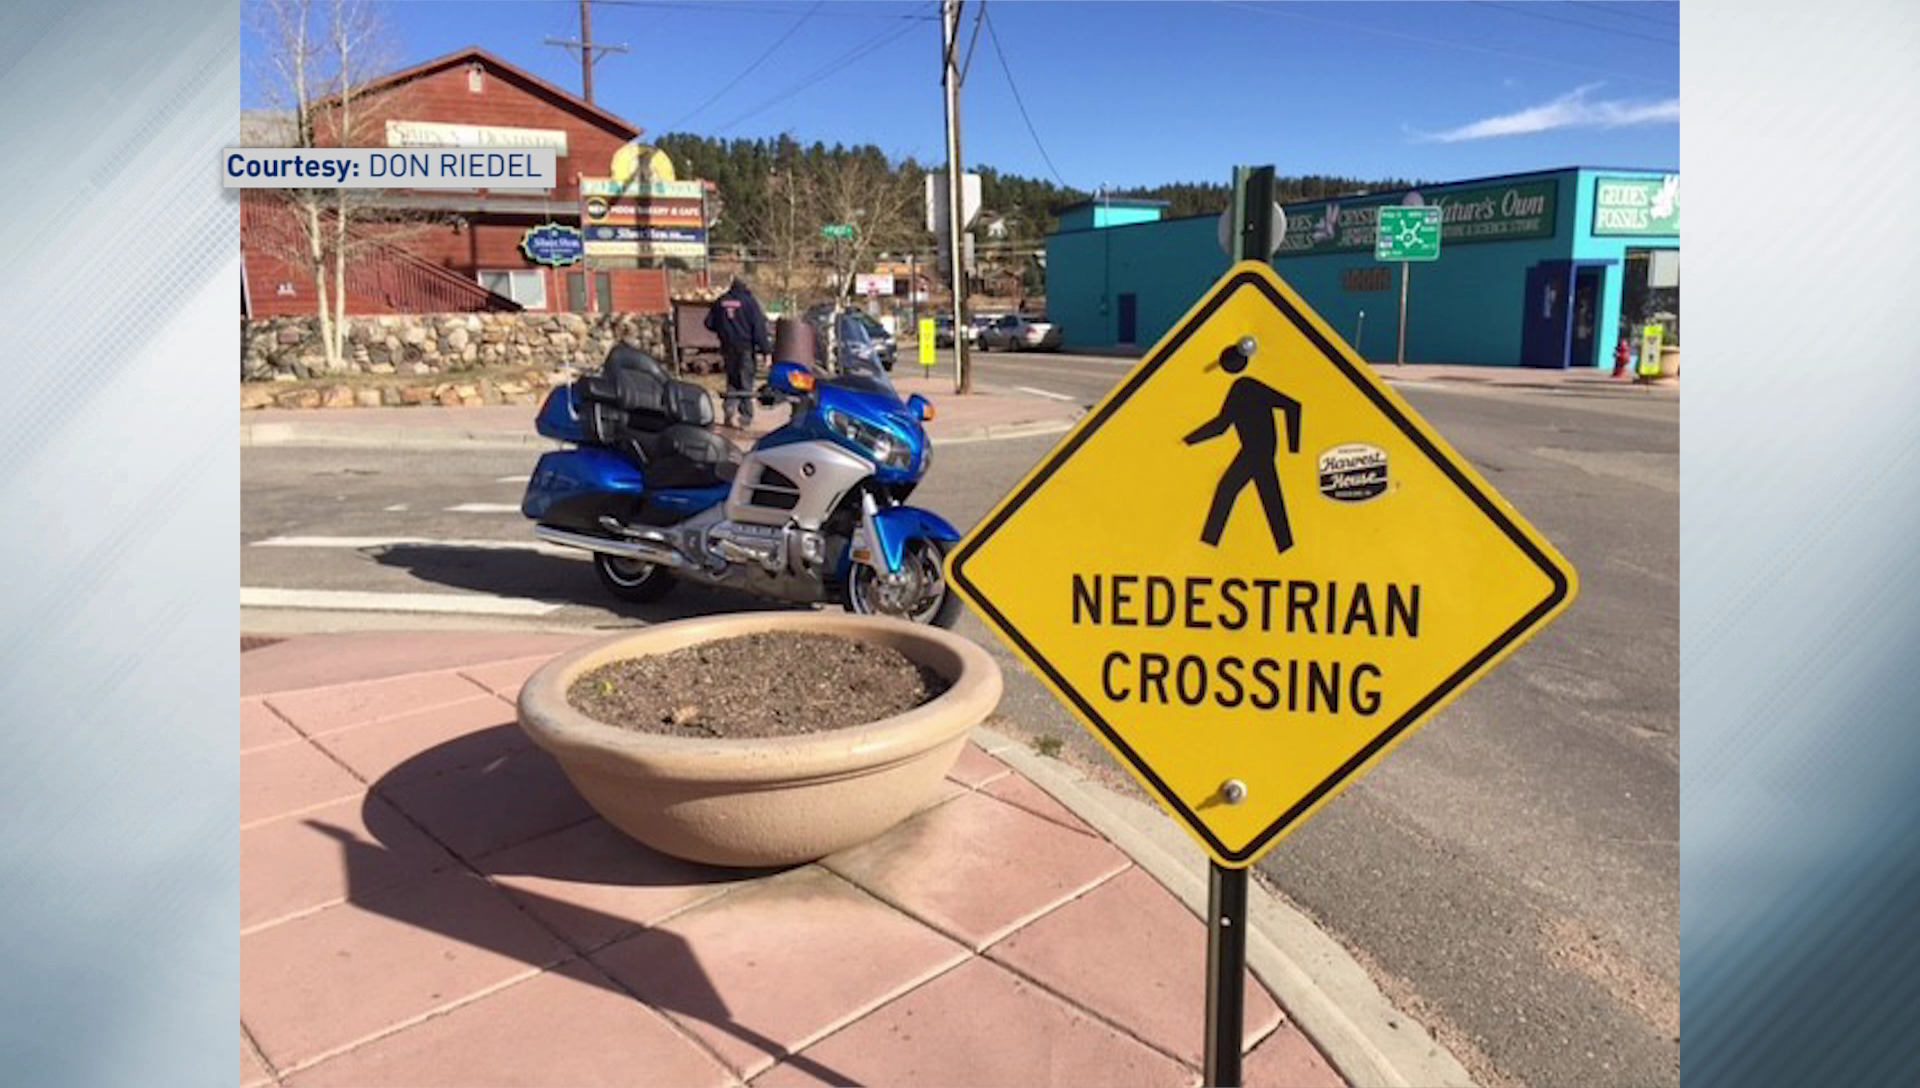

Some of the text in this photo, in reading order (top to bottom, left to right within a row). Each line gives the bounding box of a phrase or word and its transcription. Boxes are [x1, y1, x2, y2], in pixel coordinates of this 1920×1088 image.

[1501, 189, 1545, 217] Own
[1320, 452, 1386, 472] Harvest
[1325, 471, 1382, 490] House
[1072, 573, 1420, 638] NEDESTRIAN
[1102, 650, 1382, 716] CROSSING
